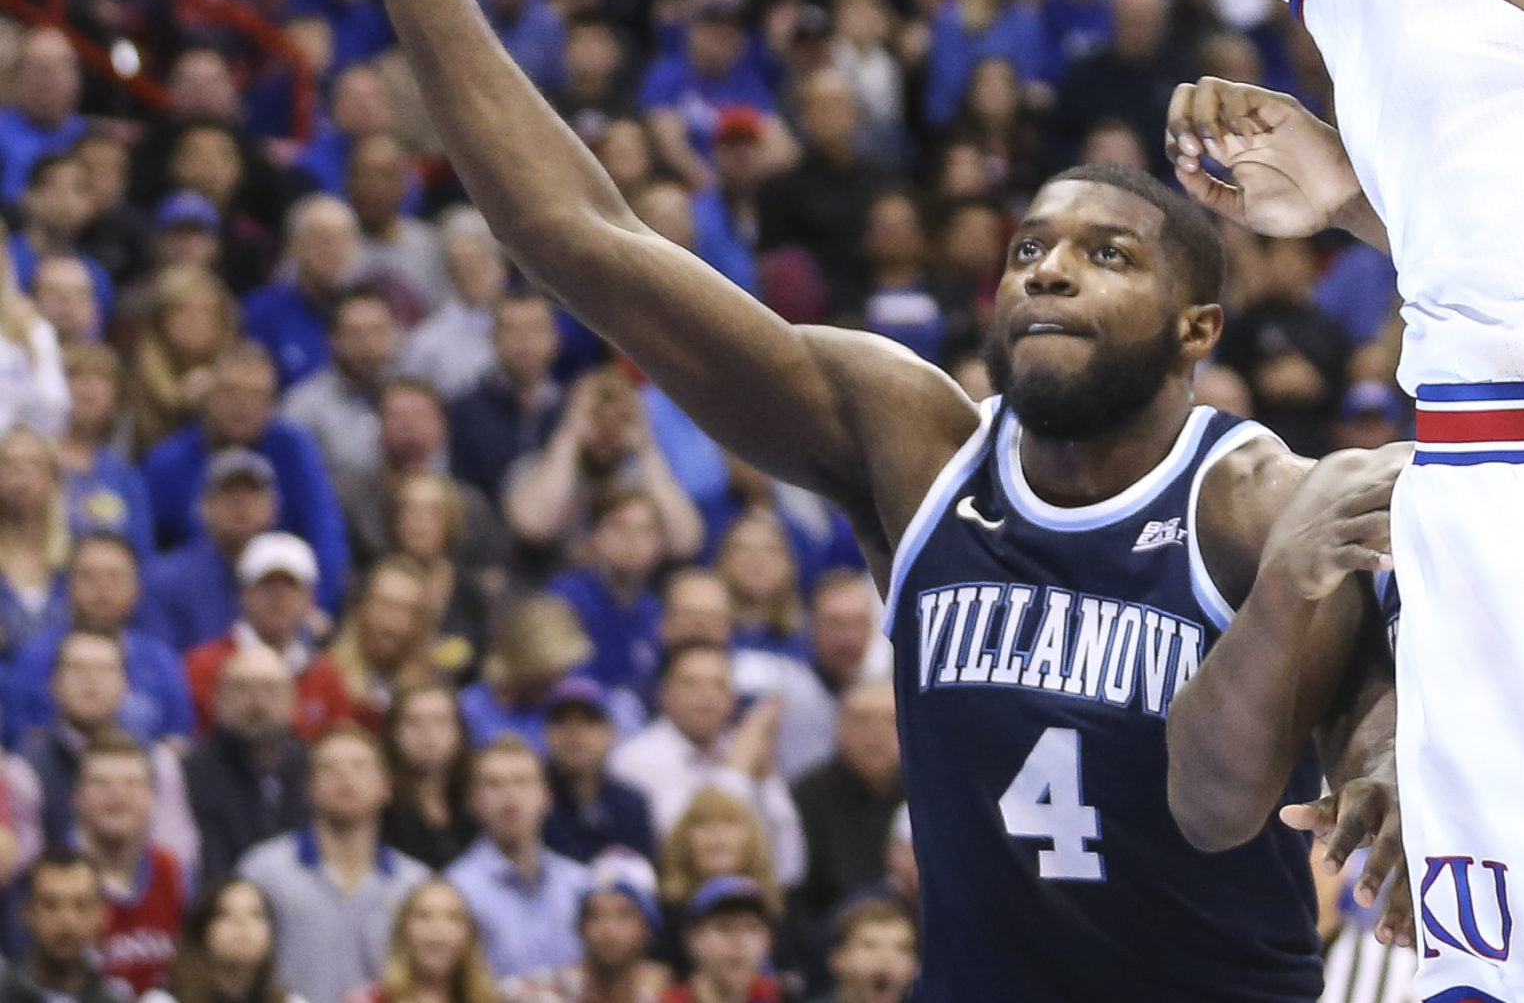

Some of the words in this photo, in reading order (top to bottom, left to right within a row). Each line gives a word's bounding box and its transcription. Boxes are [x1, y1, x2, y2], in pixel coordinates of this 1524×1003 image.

[916, 581, 1205, 719] VILLANOVA
[999, 727, 1107, 882] 4
[1420, 856, 1513, 964] KU
